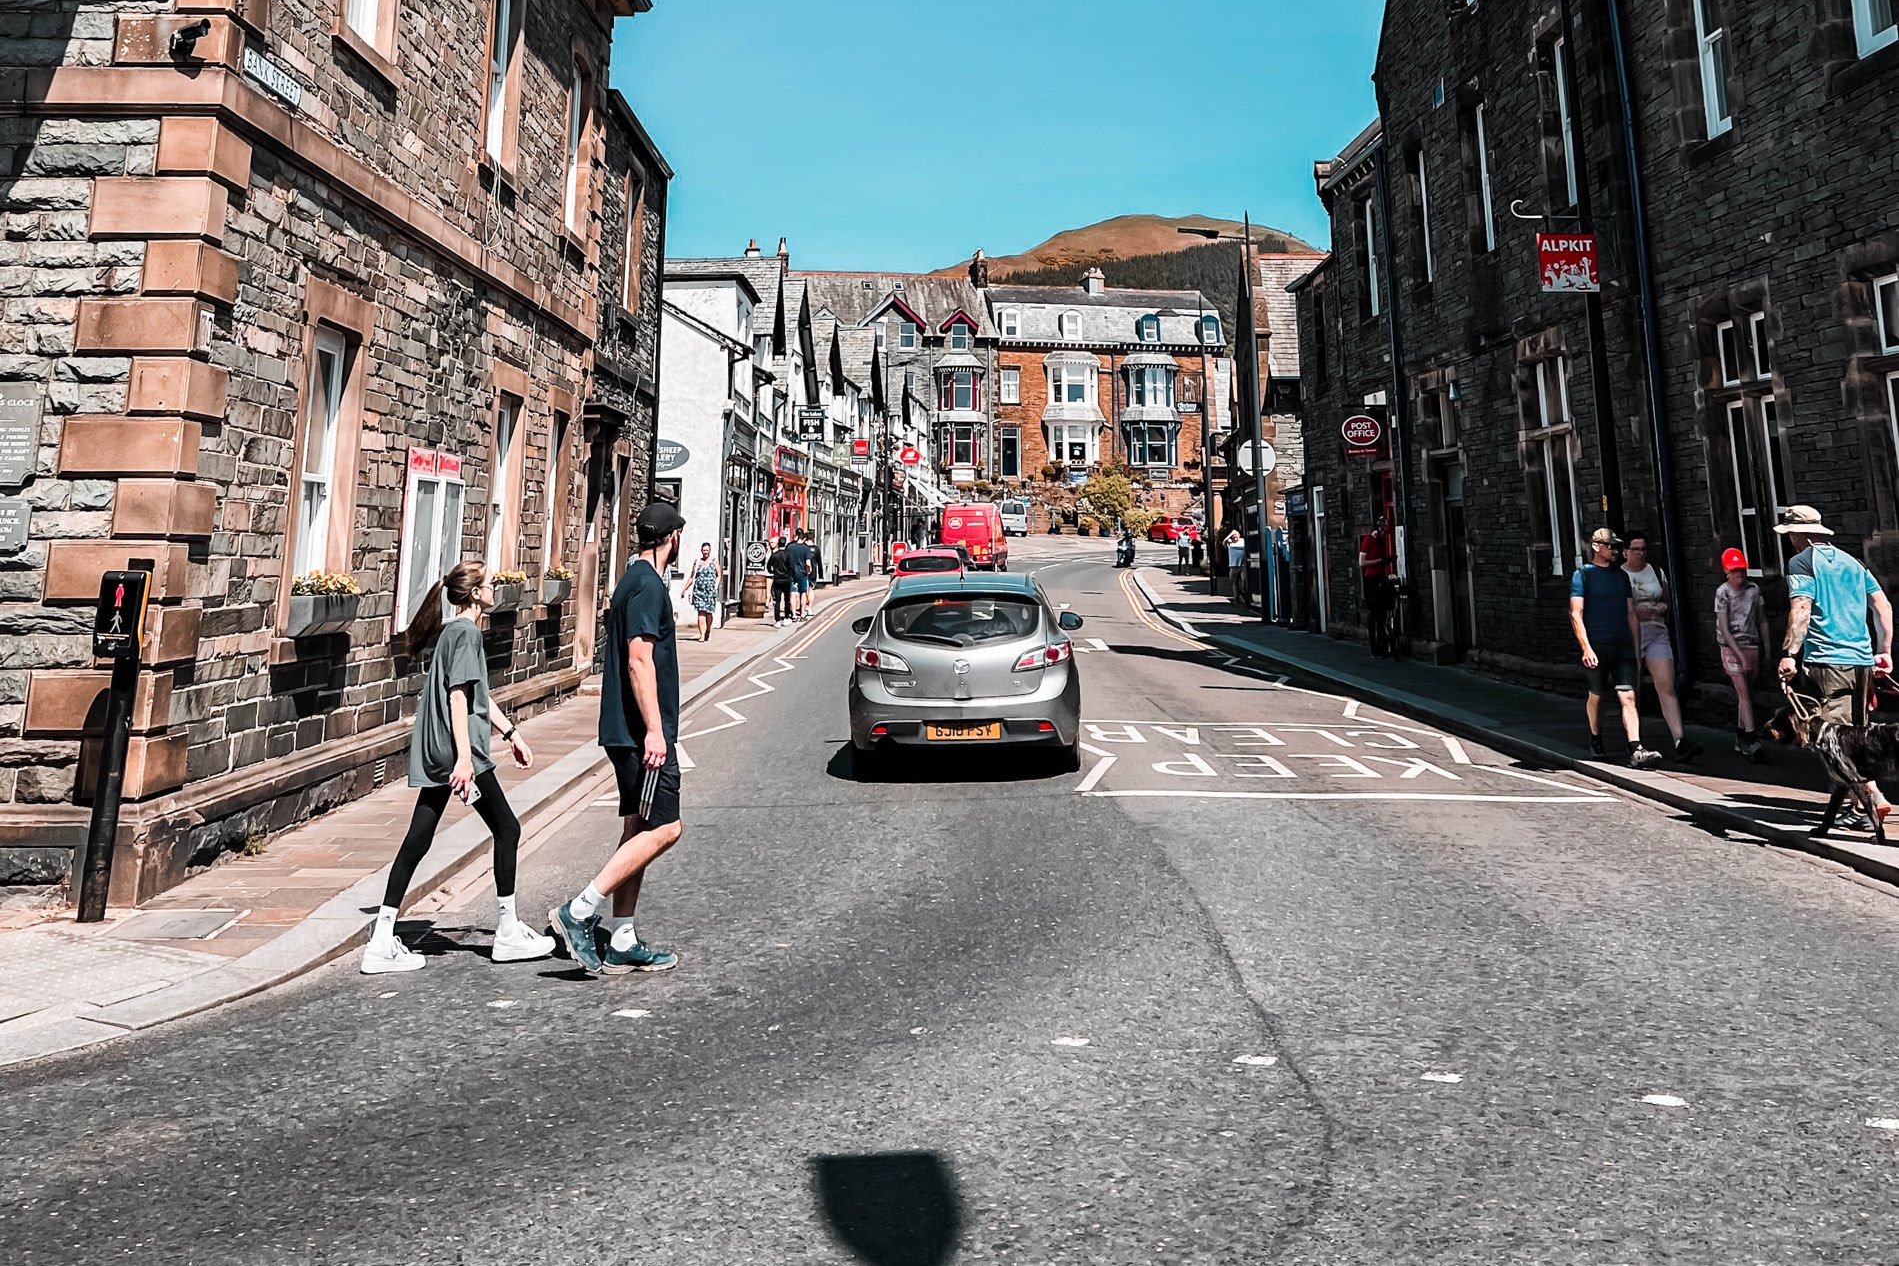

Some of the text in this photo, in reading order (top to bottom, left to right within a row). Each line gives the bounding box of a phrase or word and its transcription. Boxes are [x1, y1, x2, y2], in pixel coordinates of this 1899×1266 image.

[247, 50, 299, 102] BANK STREET
[1541, 239, 1593, 252] ALPKIT
[7, 399, 35, 407] CLOCK
[803, 419, 820, 427] FISH
[800, 433, 822, 441] CHIPS
[1347, 429, 1375, 438] OFFICE
[659, 446, 682, 454] SHEEP
[1084, 724, 1421, 749] CLEAR
[1152, 753, 1462, 780] KEEP
